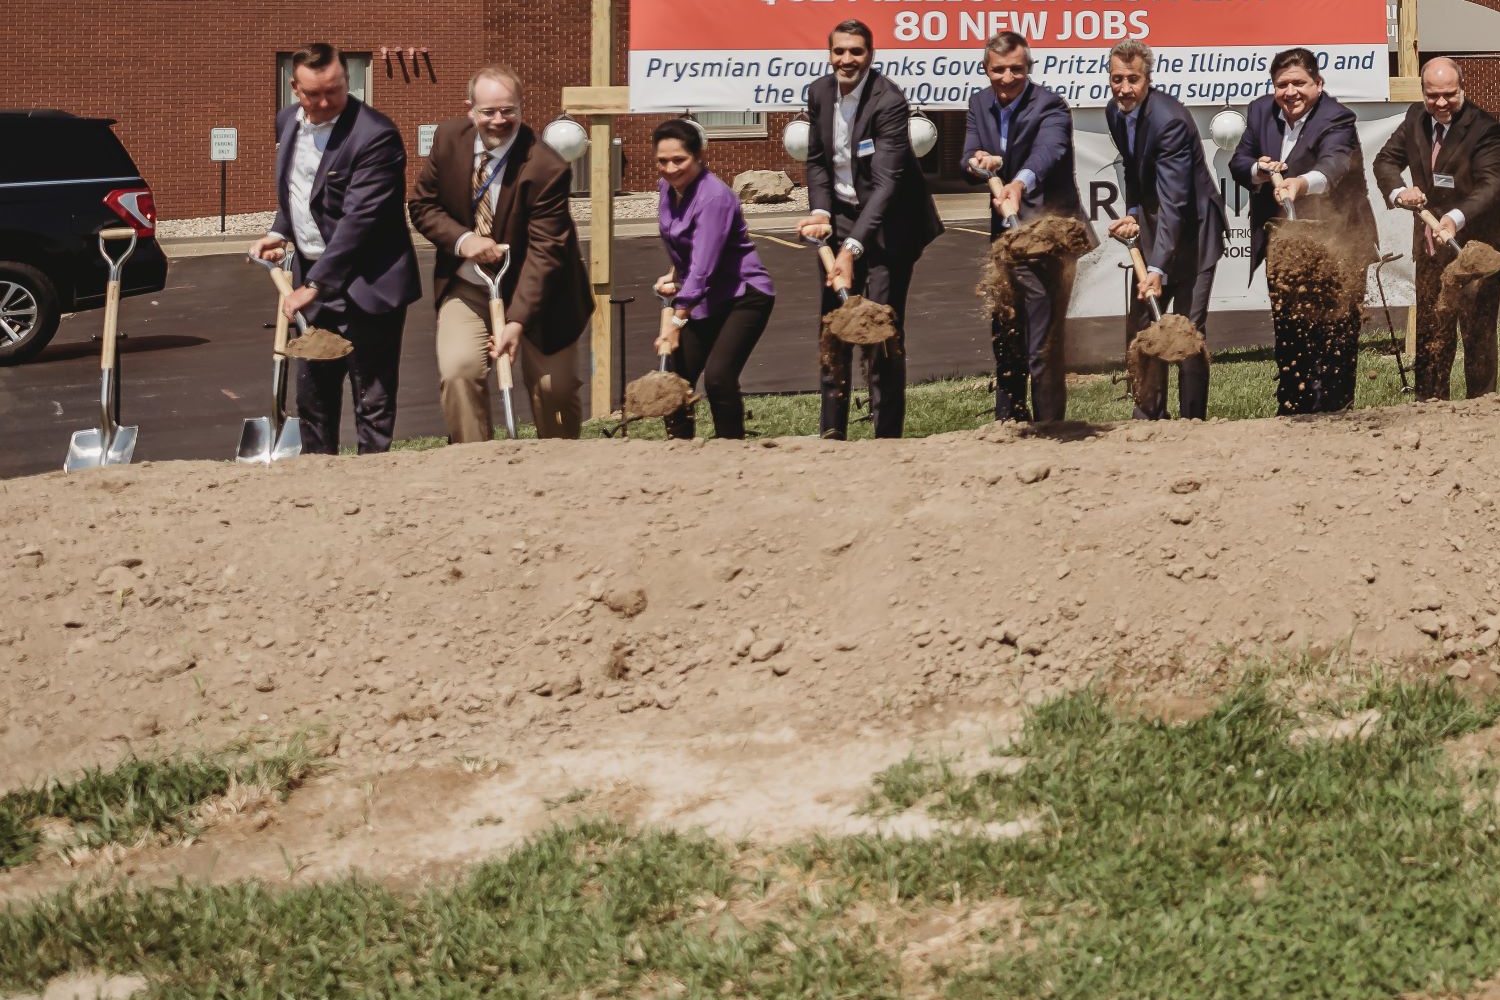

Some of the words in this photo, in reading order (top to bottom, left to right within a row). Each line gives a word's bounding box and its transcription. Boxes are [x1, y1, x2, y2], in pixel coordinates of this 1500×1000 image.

[894, 10, 949, 42] 80
[959, 10, 1048, 41] NEW
[1056, 10, 1150, 41] JOBS
[646, 57, 760, 83] Prysmian
[767, 57, 832, 77] Grou
[873, 56, 926, 76] anks
[1043, 55, 1111, 75] Pritzk
[1151, 54, 1184, 73] he
[1188, 53, 1268, 73] Illinois
[1334, 51, 1376, 71] and
[753, 83, 795, 104] the
[903, 82, 983, 106] uQuoi
